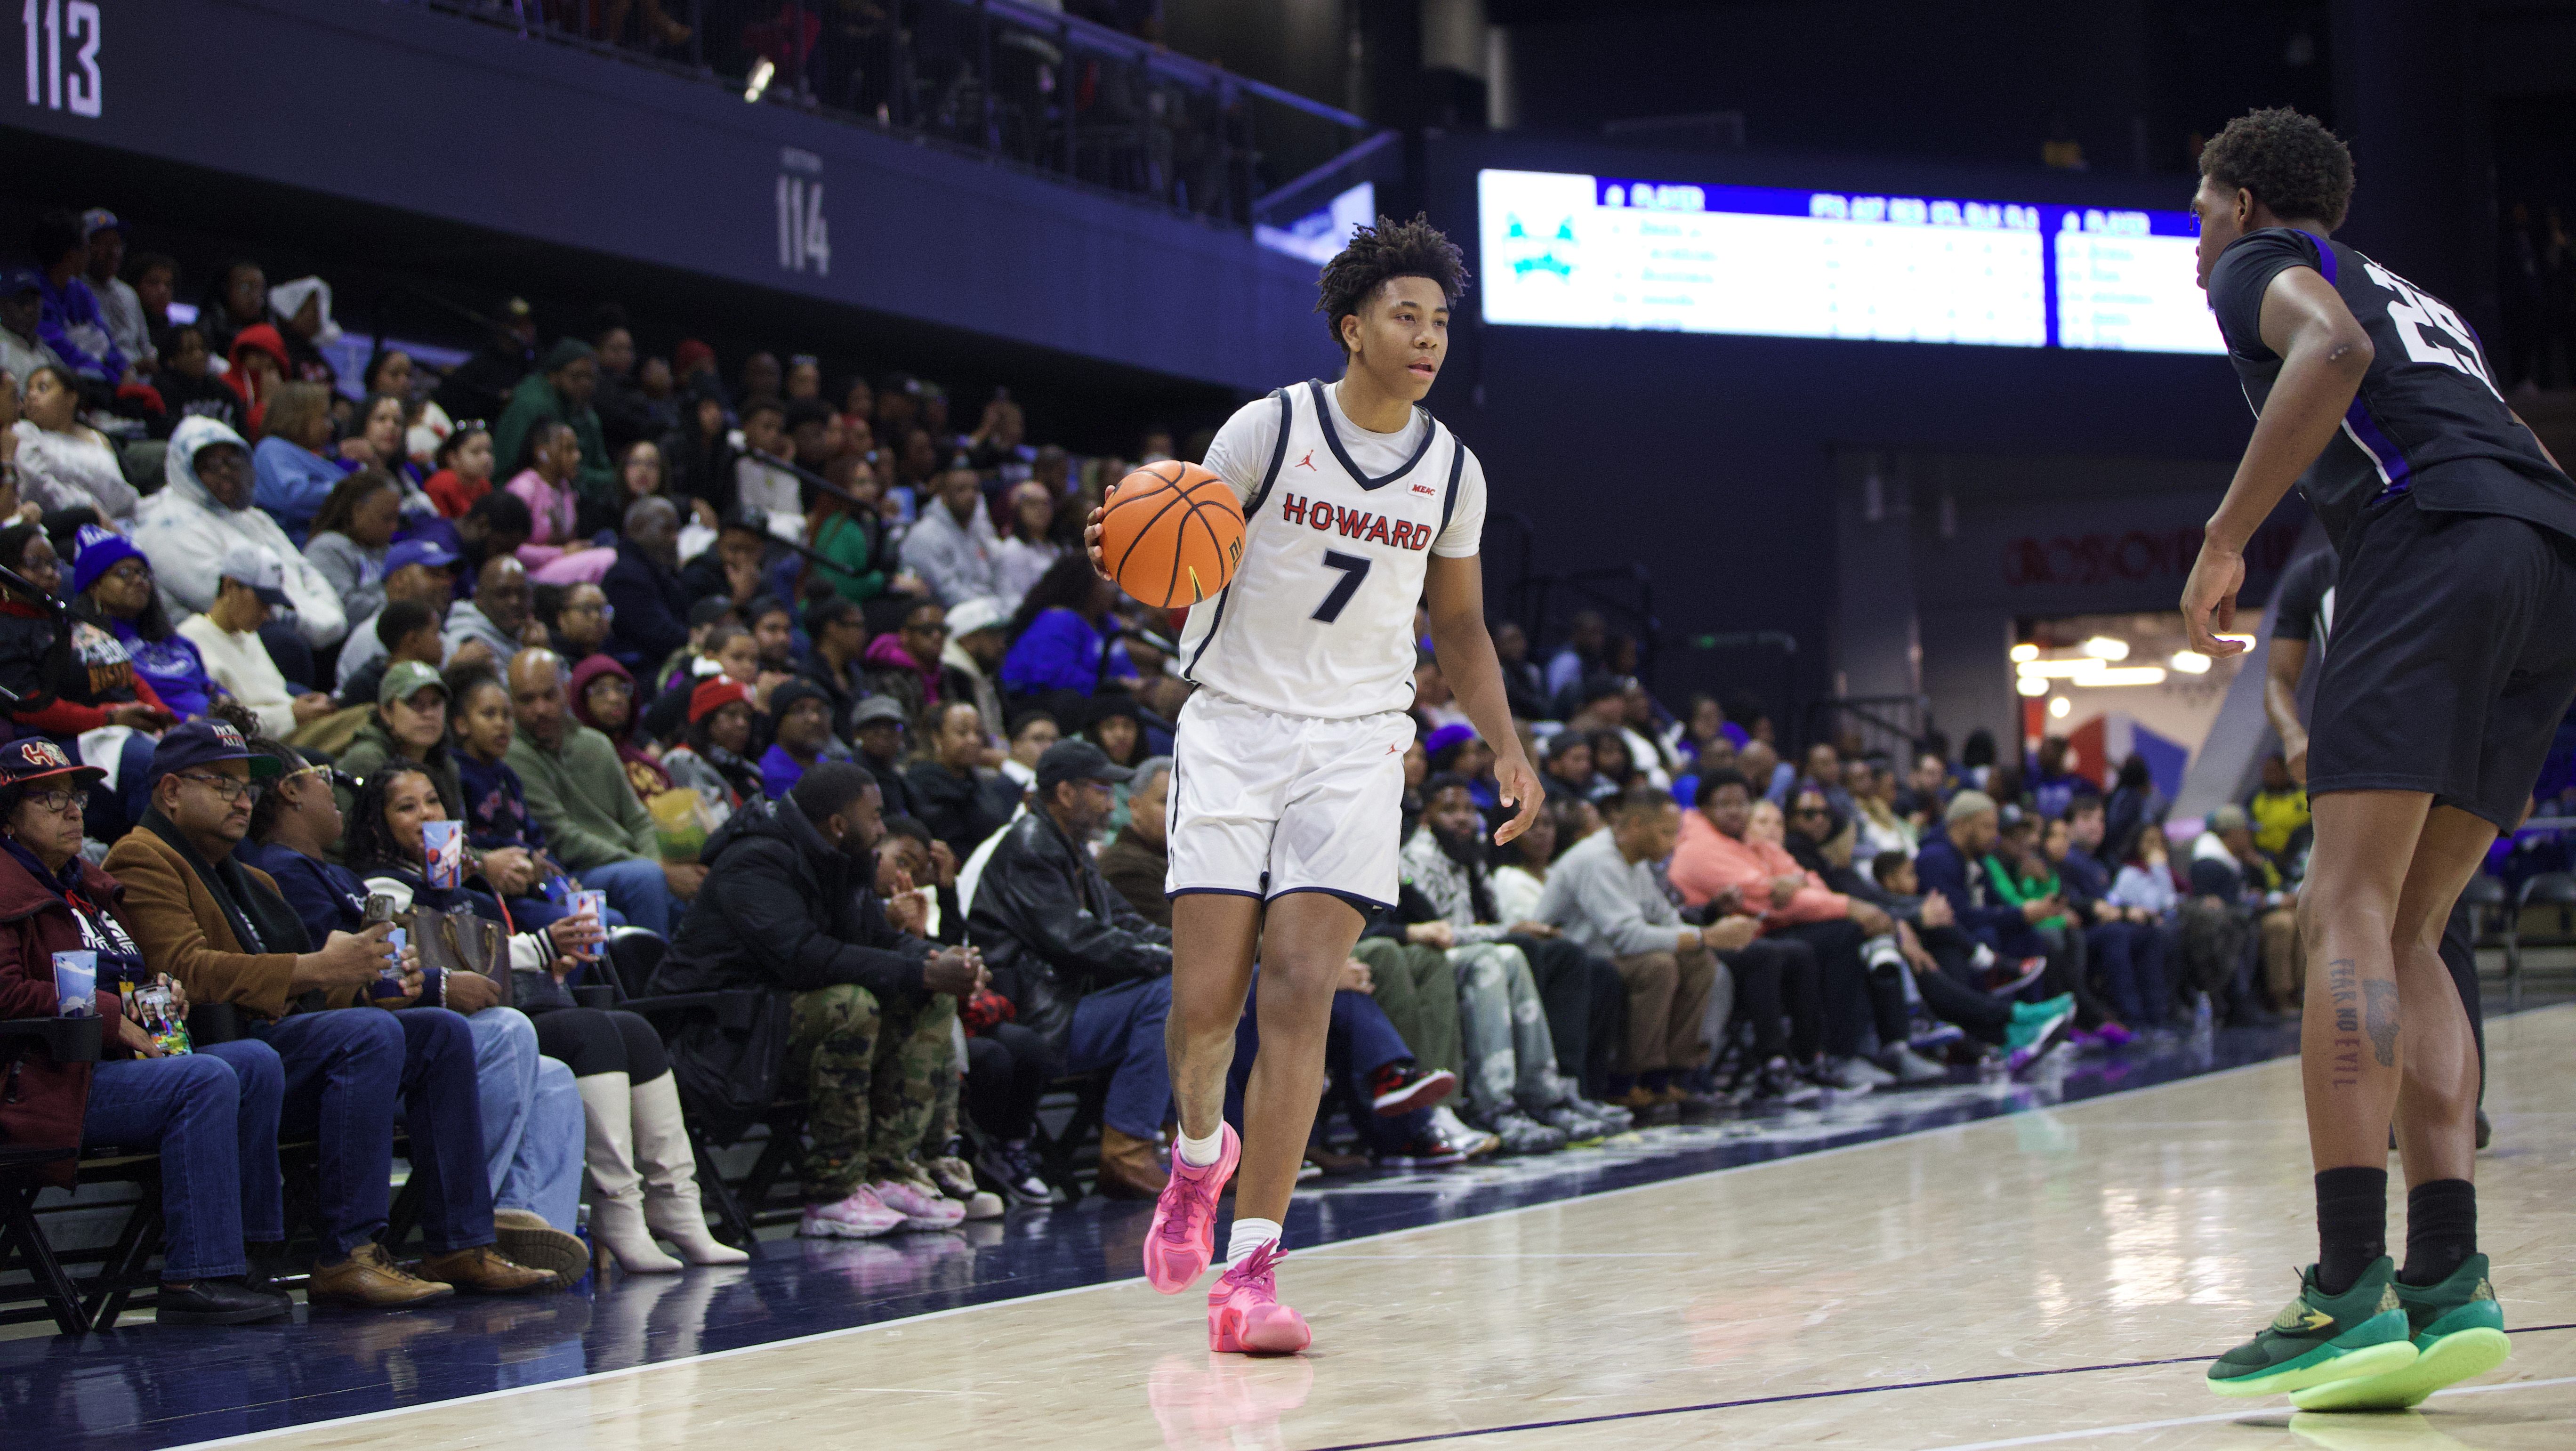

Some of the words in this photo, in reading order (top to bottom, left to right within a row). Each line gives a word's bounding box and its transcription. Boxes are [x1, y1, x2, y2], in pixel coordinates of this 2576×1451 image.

[22, 0, 102, 118] 113
[776, 176, 830, 277] 114
[1283, 492, 1432, 550] HOWARD
[1412, 484, 1436, 496] MEAC
[1309, 547, 1373, 625] 7
[2333, 1037, 2360, 1088] EVIL
